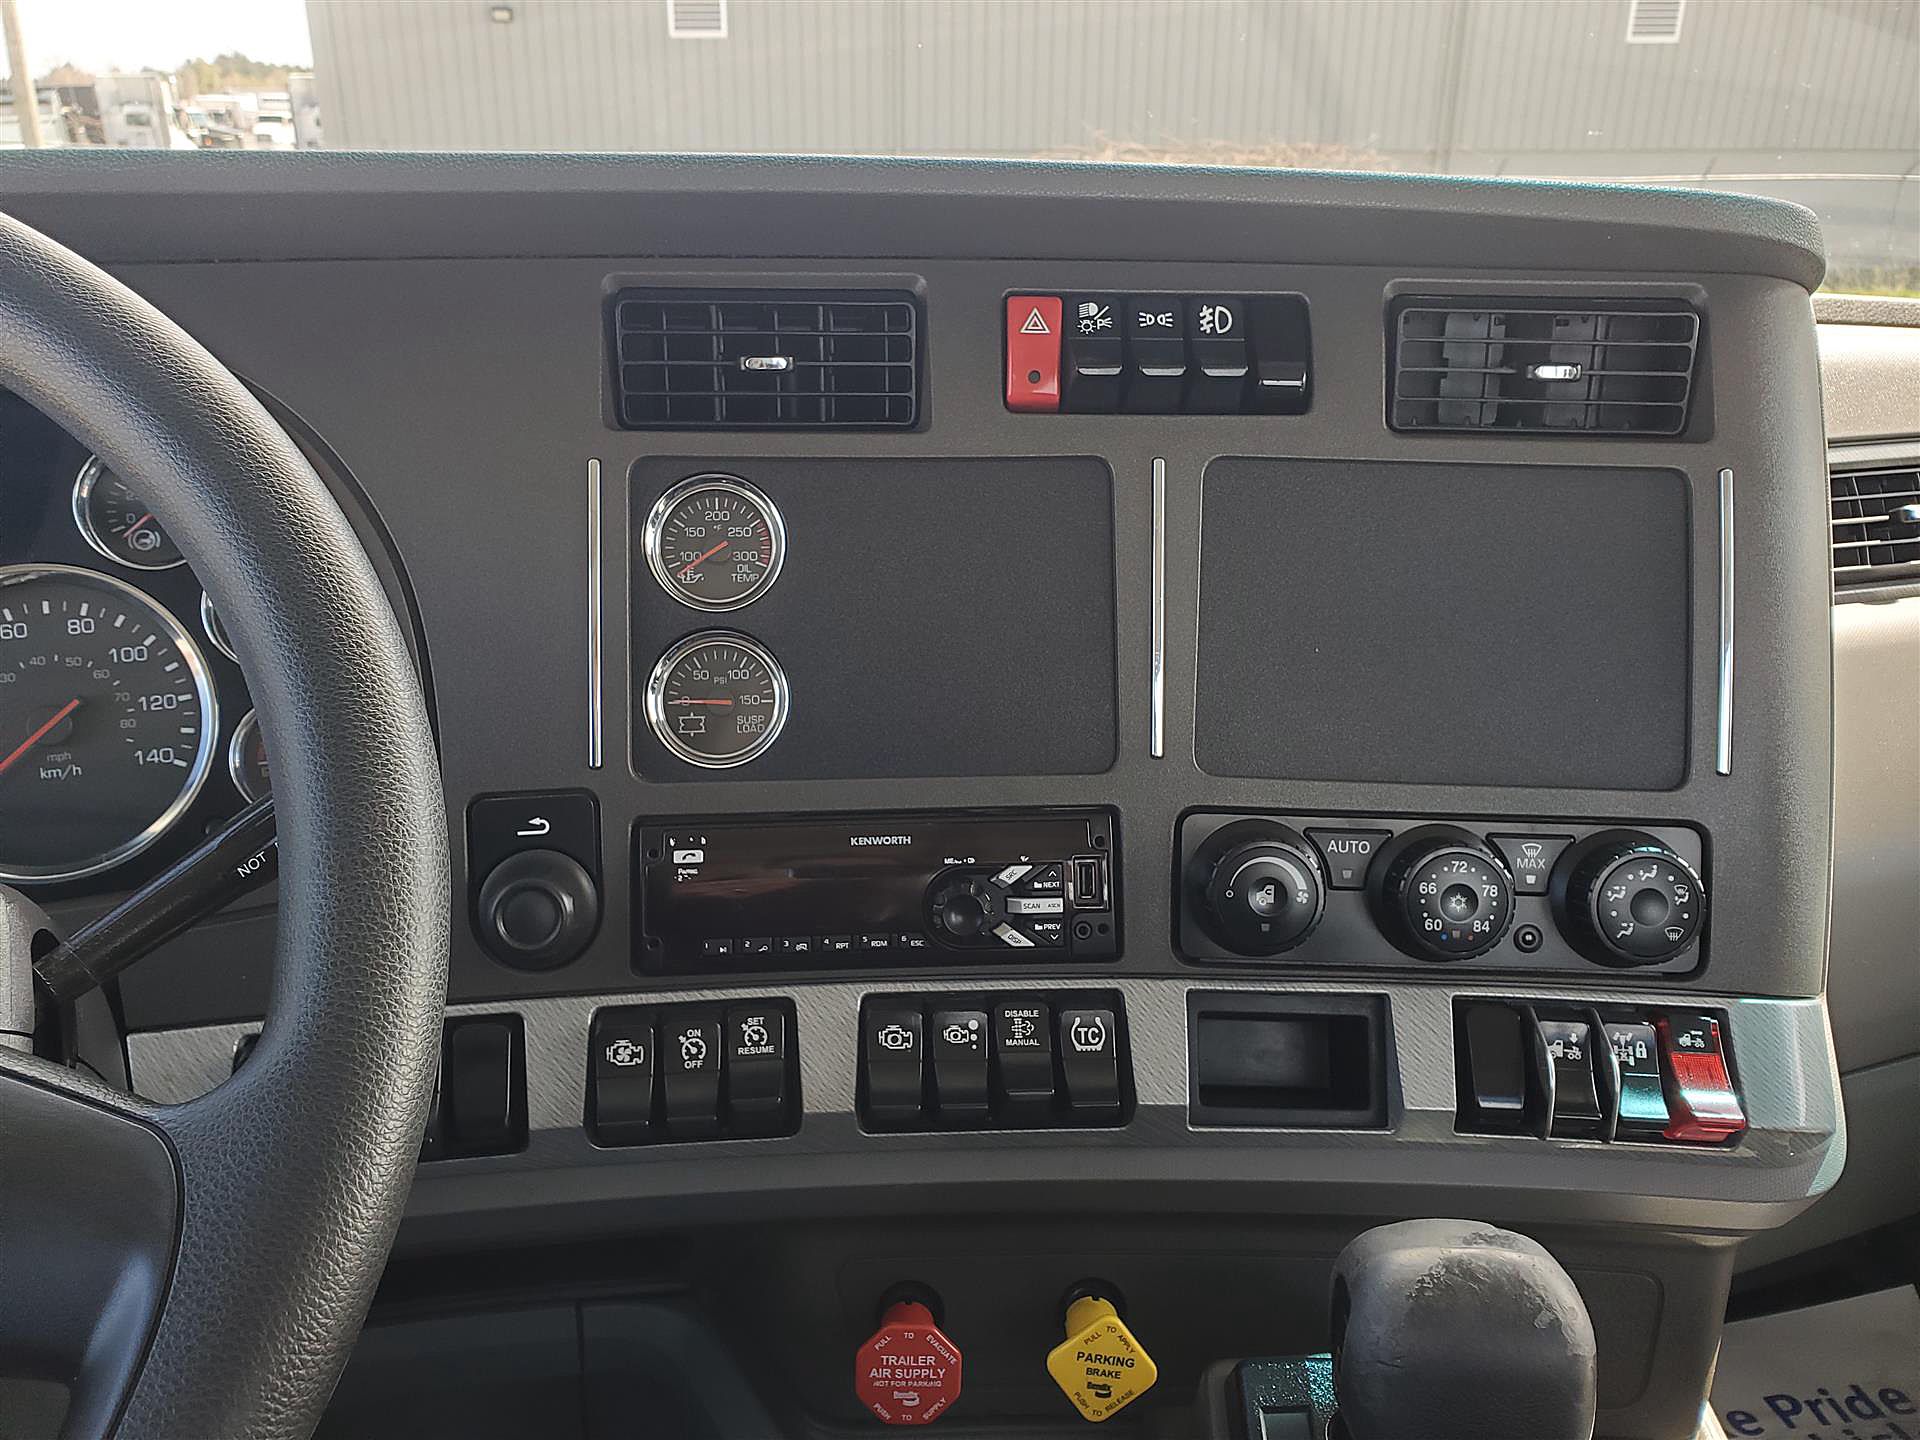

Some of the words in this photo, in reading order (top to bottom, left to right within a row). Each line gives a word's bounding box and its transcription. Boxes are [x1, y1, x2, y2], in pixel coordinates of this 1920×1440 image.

[704, 510, 730, 521] 200
[684, 527, 706, 538] 150
[728, 528, 752, 538] 250
[680, 551, 702, 562] 100
[732, 551, 758, 562] 300
[736, 564, 752, 574] OIL
[731, 573, 759, 582] TEMP
[0, 622, 28, 639] 60
[67, 618, 95, 634] 80
[108, 646, 148, 663] 100
[30, 656, 46, 666] 40
[65, 656, 82, 667] 50
[93, 669, 110, 679] 60
[693, 670, 710, 680] 50
[728, 670, 750, 680] 100
[714, 676, 728, 685] PSI
[114, 692, 130, 702] 70
[138, 694, 176, 711] 120
[739, 695, 760, 705] 150
[120, 718, 136, 728] 80
[736, 716, 764, 725] SUSP
[736, 724, 764, 734] LOAD
[46, 752, 72, 762] mph
[134, 748, 174, 765] 140
[40, 764, 82, 780] km/h
[850, 836, 912, 846] KENWORTH
[1327, 840, 1370, 854] AUTO
[236, 851, 266, 878] NOT
[1451, 861, 1468, 873] 72
[1517, 858, 1546, 870] MAX
[1420, 882, 1437, 894] 66
[1482, 885, 1498, 897] 78
[1424, 919, 1442, 930] 60
[1473, 920, 1490, 932] 84
[747, 1017, 764, 1025] SET
[1078, 1027, 1100, 1044] TC
[738, 1046, 774, 1055] RESUME
[684, 1060, 703, 1068] OFF
[1084, 1332, 1102, 1346] PULL
[1117, 1334, 1136, 1354] APPLY
[874, 1335, 892, 1351] PULL
[926, 1334, 958, 1365] EVACUATE
[880, 1356, 936, 1366] TRAILER
[1076, 1351, 1135, 1368] PARKING
[869, 1368, 892, 1378] AIR
[895, 1368, 946, 1378] SUPPLY
[1086, 1368, 1122, 1379] BRAKE
[1074, 1391, 1090, 1410] PUSH
[1105, 1389, 1134, 1412] RELEASE
[872, 1402, 892, 1420] PUSH
[922, 1397, 947, 1420] SUPPLY
[1762, 1384, 1917, 1430] Pride
